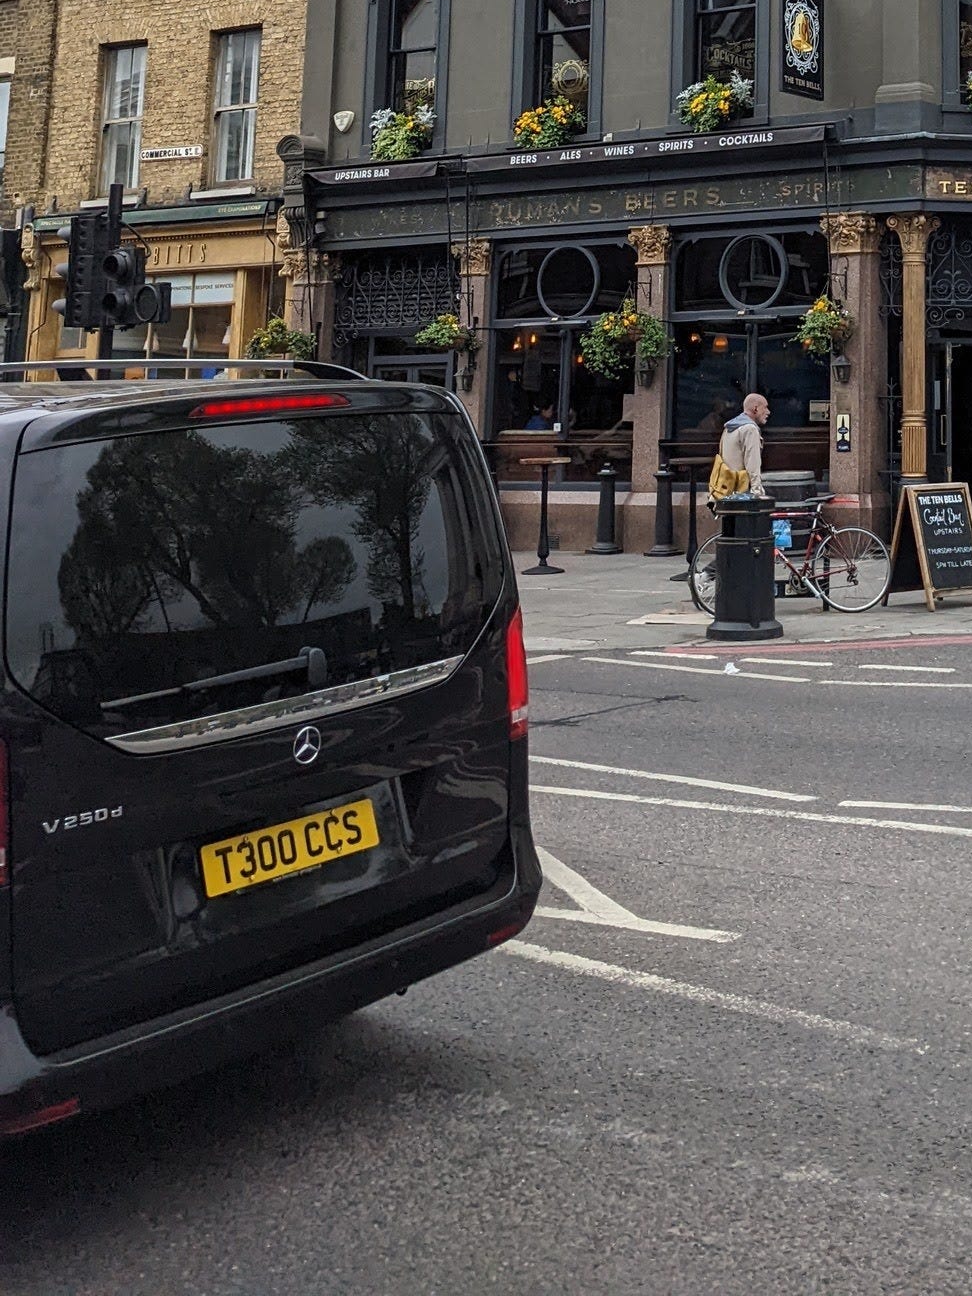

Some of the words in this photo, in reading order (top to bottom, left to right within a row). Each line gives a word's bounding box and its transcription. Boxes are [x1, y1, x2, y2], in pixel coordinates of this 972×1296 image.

[784, 75, 795, 84] THE
[795, 77, 806, 87] TEN
[141, 148, 182, 159] COMMERCIAL
[510, 154, 537, 165] BEERS
[560, 150, 581, 161] ALES
[604, 145, 635, 157] WINES
[658, 139, 694, 152] SPIRITS
[718, 132, 774, 147] COCKTAILS
[334, 169, 372, 181] UPSTAIRS
[373, 168, 390, 179] BAR
[625, 186, 721, 212] BEERS
[153, 243, 207, 266] BITTS
[918, 496, 931, 505] THE
[931, 495, 944, 504] TEN
[944, 494, 962, 504] BELLS
[946, 508, 965, 527] Bar
[933, 527, 963, 536] UPSTAIRS
[947, 560, 959, 568] TILL
[960, 559, 972, 567] LATE
[215, 829, 297, 884] T300
[304, 809, 362, 859] CCS
